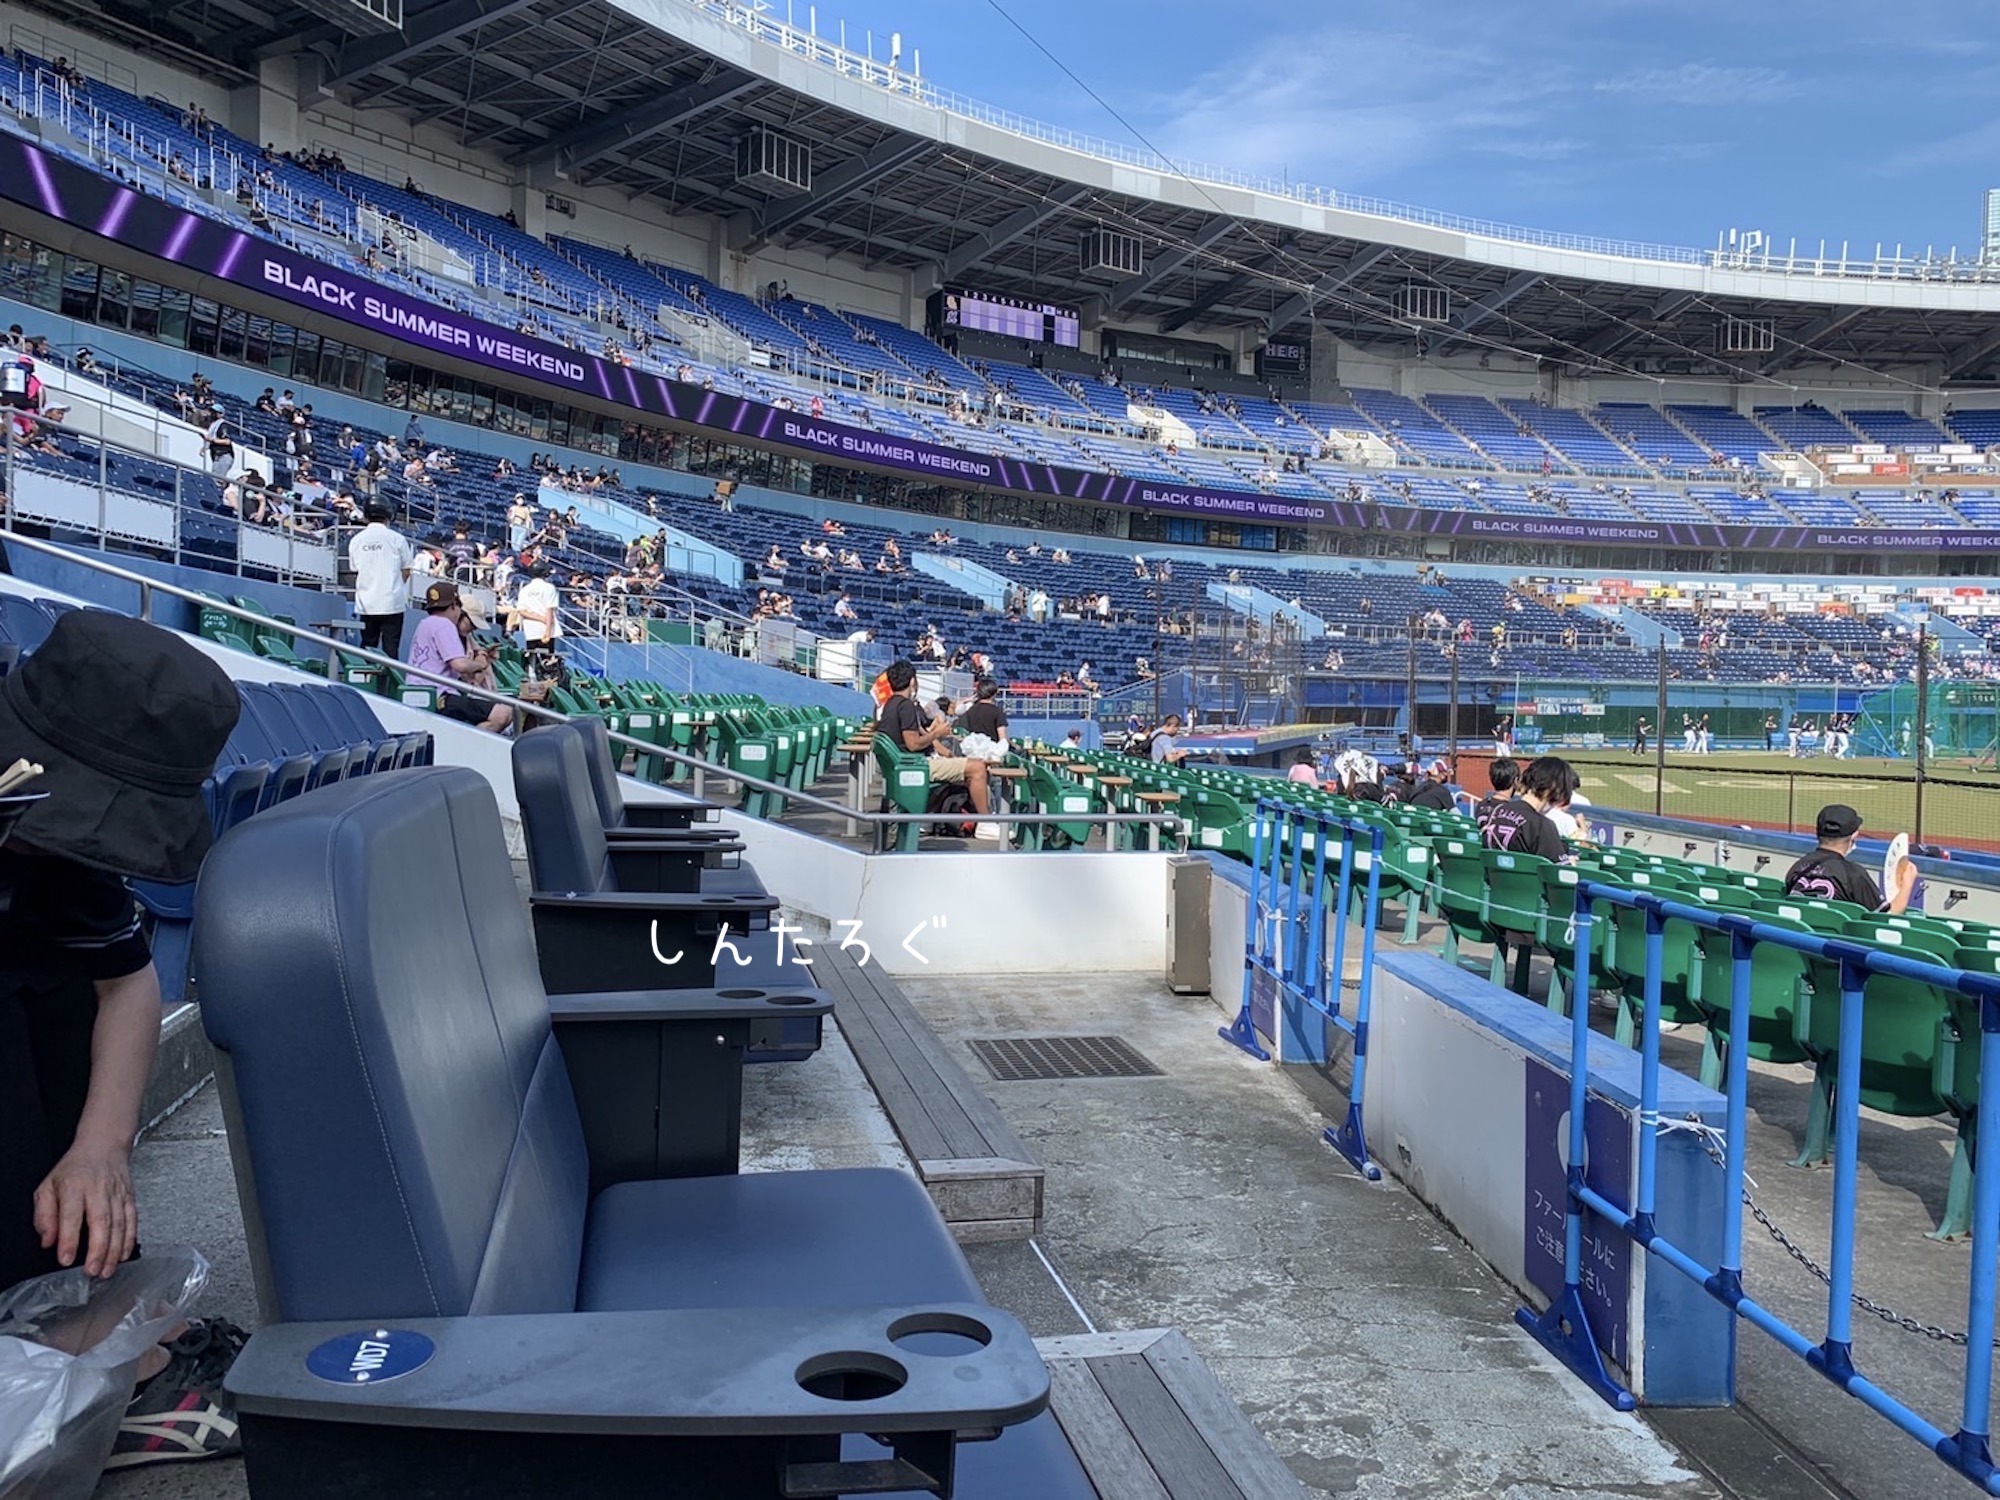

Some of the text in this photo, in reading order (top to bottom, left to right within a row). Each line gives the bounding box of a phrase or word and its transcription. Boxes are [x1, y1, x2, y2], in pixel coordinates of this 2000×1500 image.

[264, 259, 585, 382] BLACK SUMMER WEEKEND
[784, 422, 990, 477] BLACK SUMMER WEEKEND
[1142, 489, 1325, 518] BLACK SUMMER WEEKEND
[1472, 520, 1658, 539] BLACK SUMMER WEEKEND
[1817, 534, 1868, 545] BLACK
[1873, 535, 1943, 546] SUMMER
[1486, 823, 1517, 850] 17
[349, 1340, 391, 1372] W07
